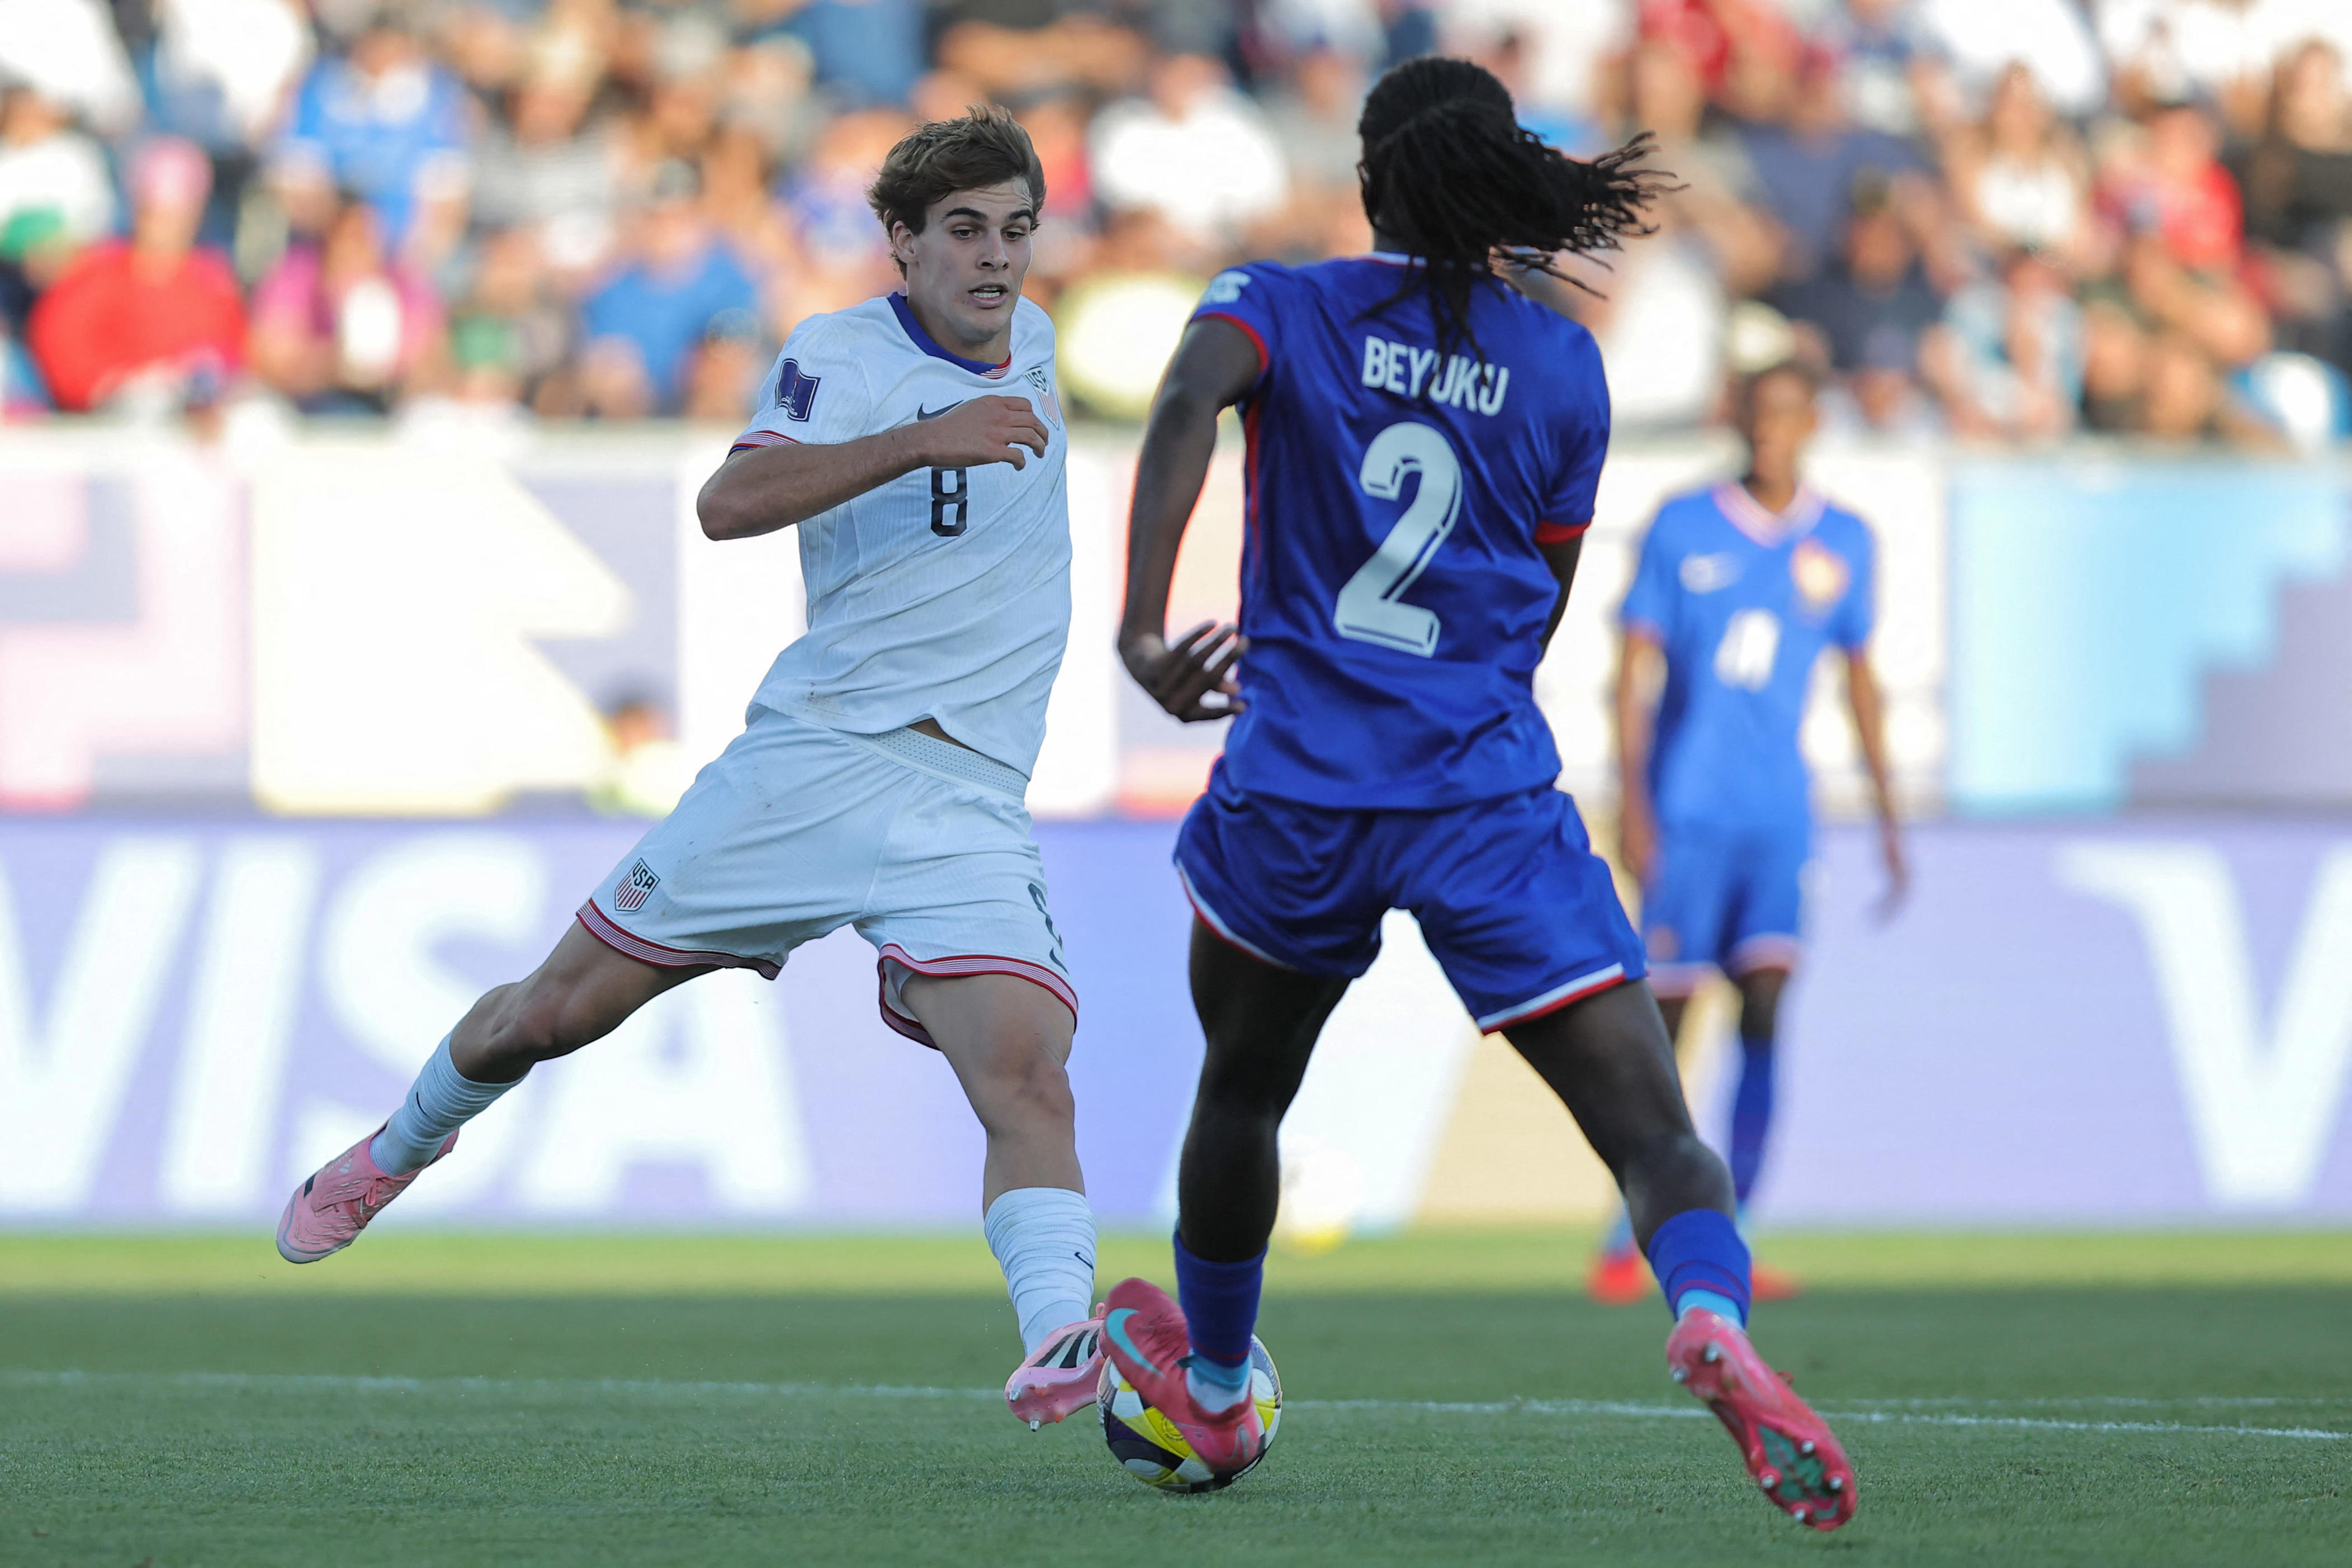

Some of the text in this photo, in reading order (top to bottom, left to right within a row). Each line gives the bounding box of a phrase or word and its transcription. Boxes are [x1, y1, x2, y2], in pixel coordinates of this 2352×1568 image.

[1024, 370, 1048, 392] USA
[1361, 335, 1510, 417] BEYUKU
[930, 466, 967, 537] 8
[1334, 421, 1463, 658] 2
[632, 861, 656, 889] USA
